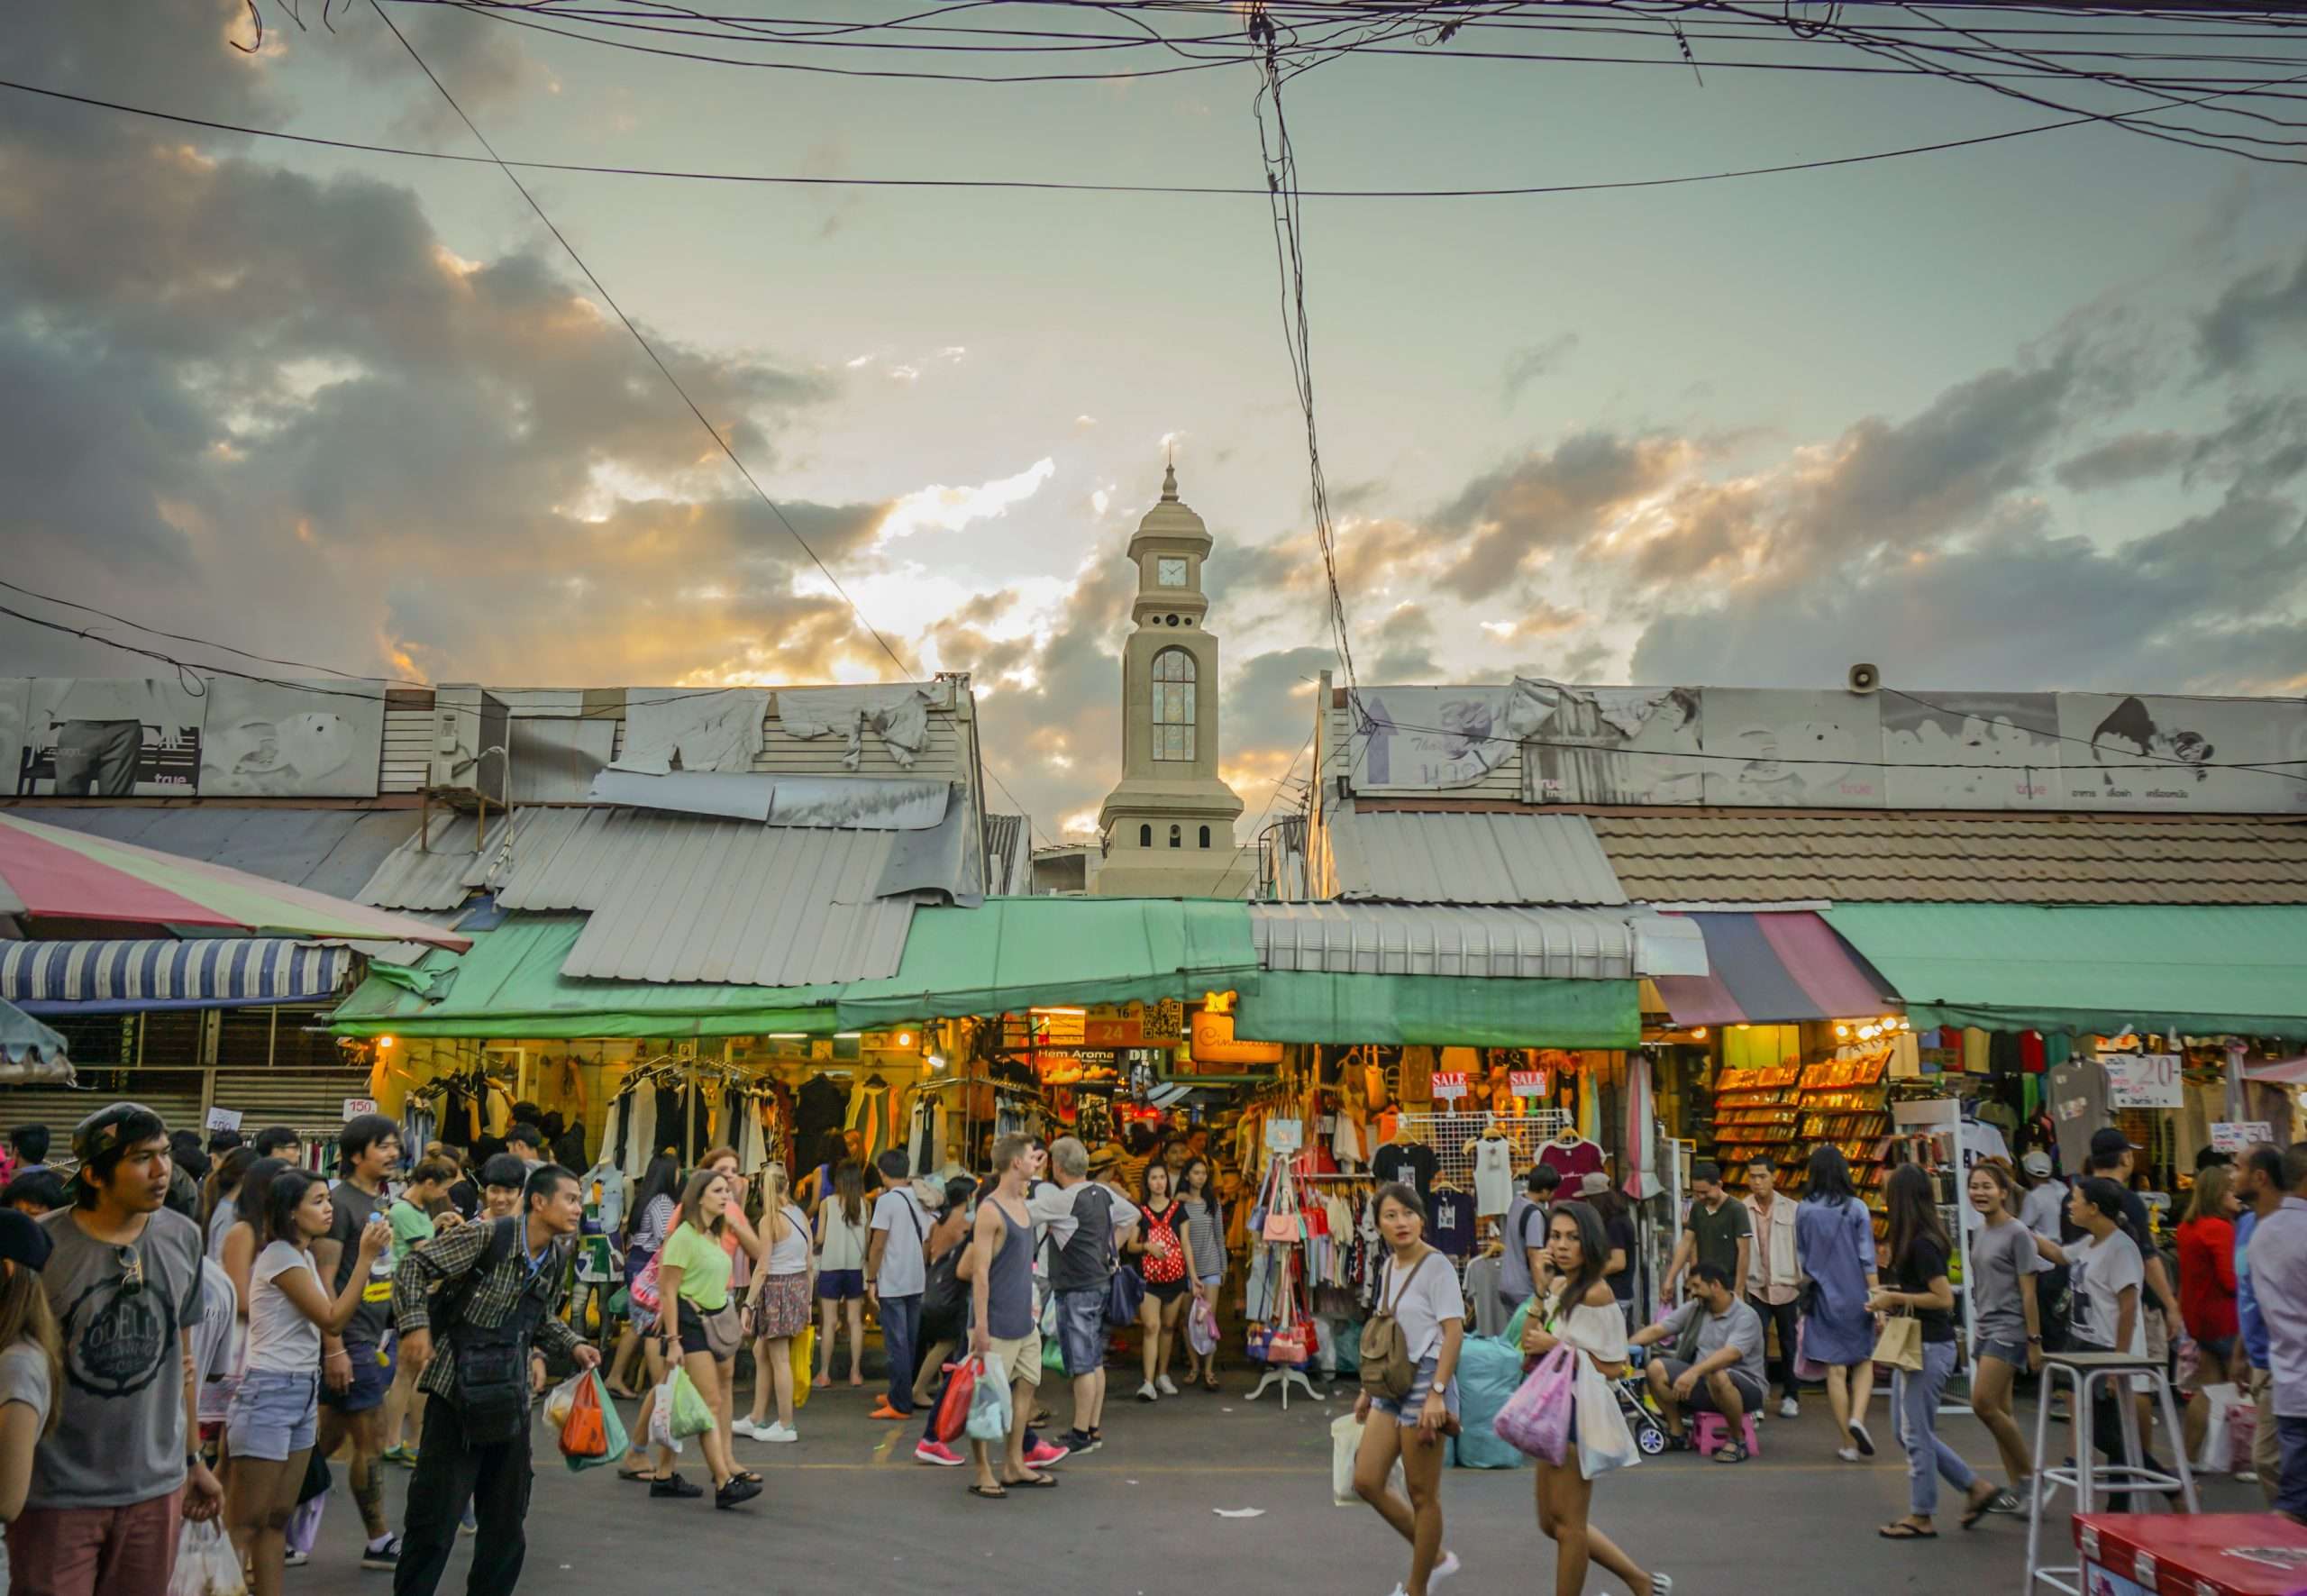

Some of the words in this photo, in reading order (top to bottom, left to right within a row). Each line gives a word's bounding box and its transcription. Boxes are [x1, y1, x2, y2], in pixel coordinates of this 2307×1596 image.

[154, 772, 187, 784] true
[1117, 1008, 1130, 1018] 16
[1102, 1025, 1123, 1041] 24
[1038, 1049, 1068, 1058] Hem
[1072, 1049, 1115, 1059] Aroma
[1432, 1072, 1466, 1087] SALE
[1511, 1072, 1546, 1085] SALE
